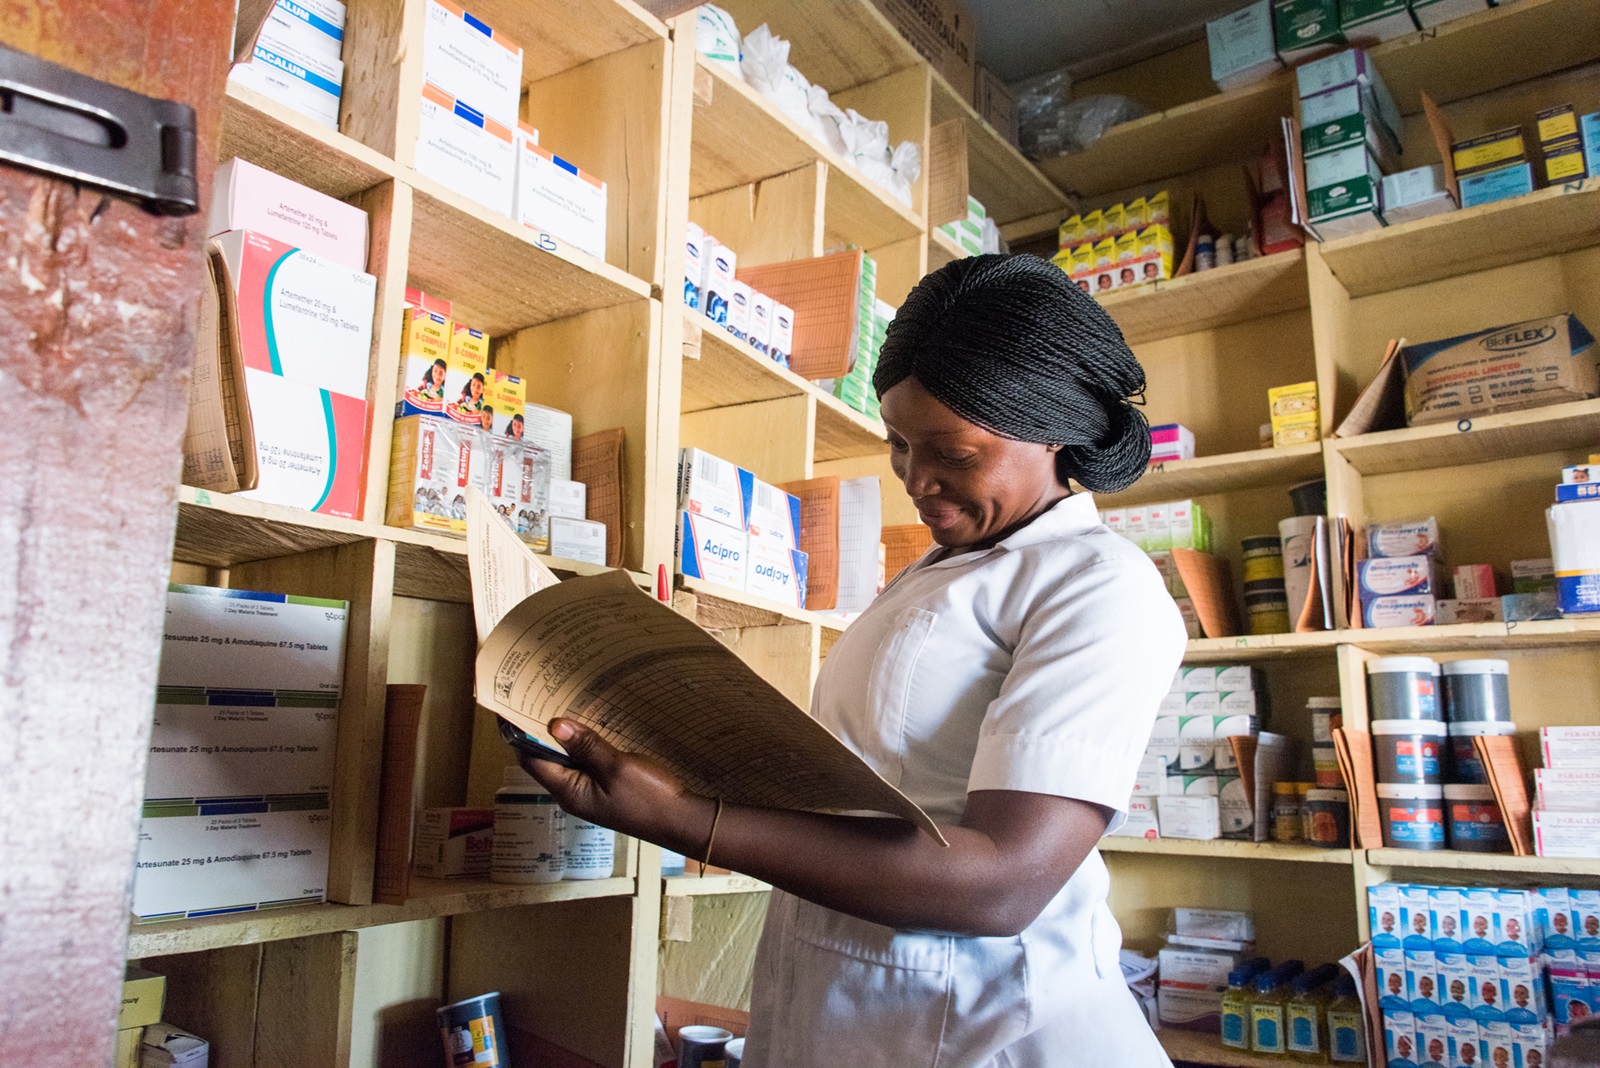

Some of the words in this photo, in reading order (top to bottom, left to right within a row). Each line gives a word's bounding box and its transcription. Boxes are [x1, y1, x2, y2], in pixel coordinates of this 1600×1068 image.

[280, 203, 307, 218] Artemether
[308, 214, 314, 222] 20
[316, 218, 323, 227] mg
[312, 226, 319, 236] mg
[321, 228, 338, 240] Tablets
[534, 234, 557, 251] B
[280, 288, 313, 304] Artemether
[314, 299, 321, 308] 20
[322, 304, 331, 314] mg
[280, 300, 318, 319] Lumefantrine
[320, 312, 328, 322] 120
[330, 318, 338, 328] mg
[340, 319, 359, 332] Tablets
[424, 326, 440, 337] VITAMIN
[416, 332, 446, 349] B-COMPLEX
[424, 346, 437, 356] SYRUP
[455, 347, 485, 363] B-COMPLEX
[458, 447, 468, 480] Zestup
[713, 506, 731, 518] Acipro
[769, 529, 785, 540] Acipro
[704, 539, 740, 561] Acipro
[755, 564, 790, 585] Acipro
[232, 638, 278, 648] Amodiaquine
[501, 650, 518, 674] FEDERAL
[506, 652, 521, 676] MINISTRY
[515, 650, 531, 670] HEALTH
[221, 746, 268, 754] Amodiaquine
[136, 860, 180, 869] Artesunate
[214, 854, 260, 863] Amodiaquine
